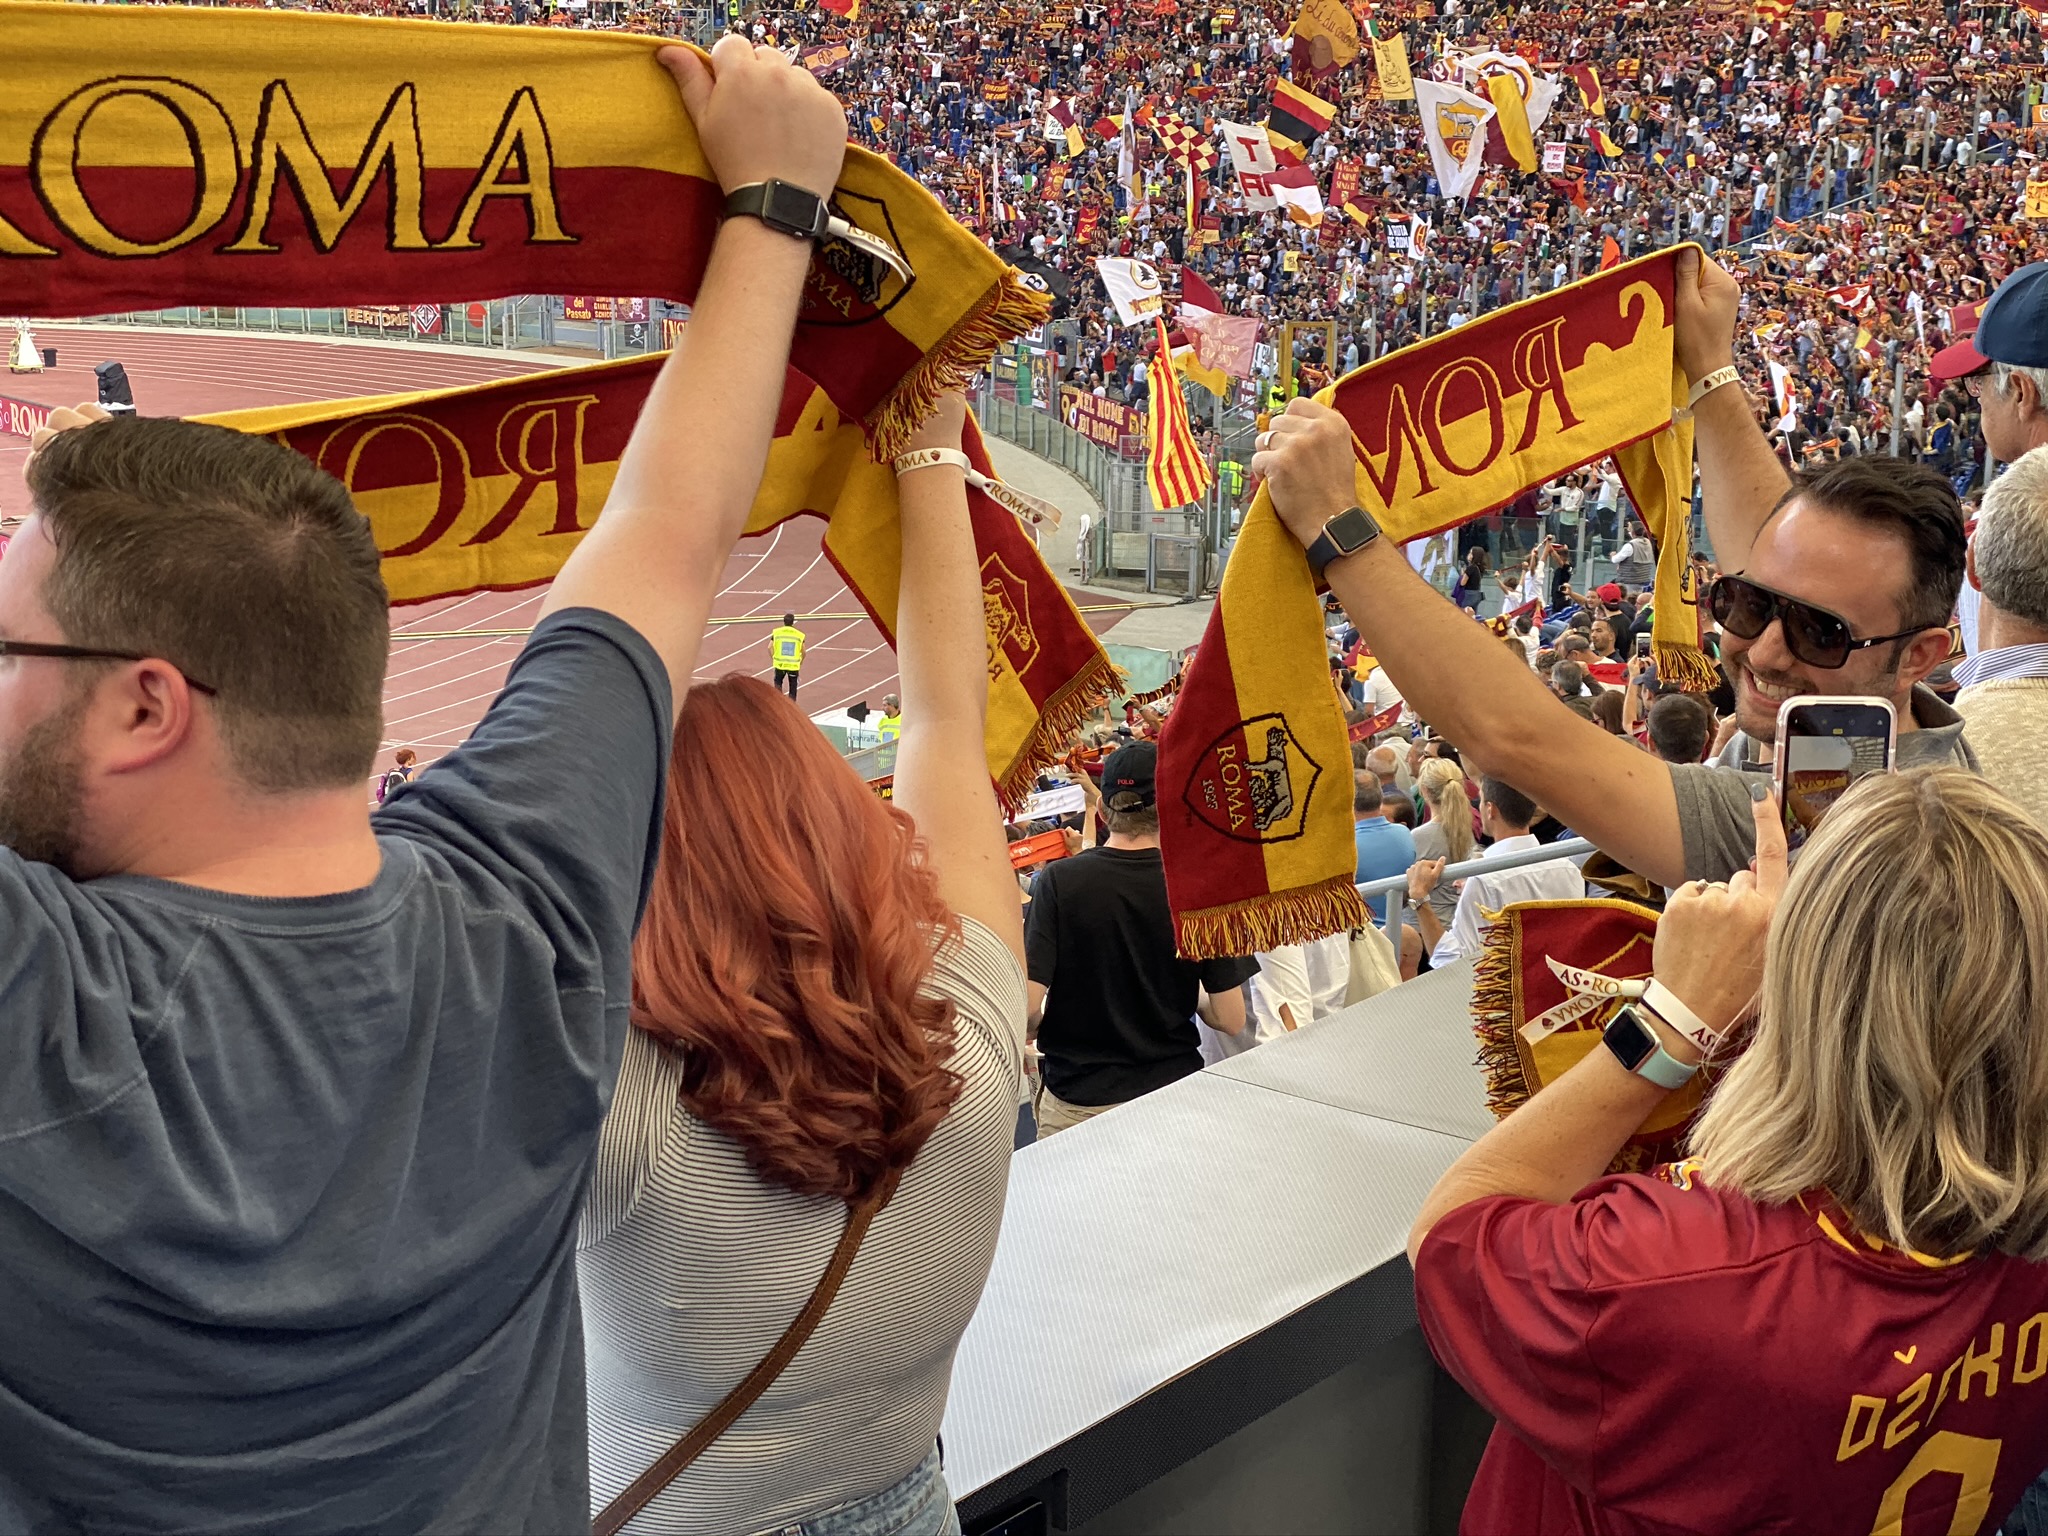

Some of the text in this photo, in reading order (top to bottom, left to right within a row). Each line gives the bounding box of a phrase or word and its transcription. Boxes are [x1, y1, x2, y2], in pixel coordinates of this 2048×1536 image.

[0, 75, 581, 259] OMA
[565, 307, 592, 319] Passato
[573, 296, 585, 309] del
[347, 307, 410, 328] BERTONE
[1712, 367, 1738, 386] OMA
[9, 402, 49, 436] ROM
[1096, 398, 1125, 426] NOME
[1091, 419, 1118, 446] ROMA
[895, 450, 929, 472] OMA
[989, 482, 1031, 520] ROMA
[1117, 778, 1135, 786] POLO
[1216, 743, 1248, 832] ROMA
